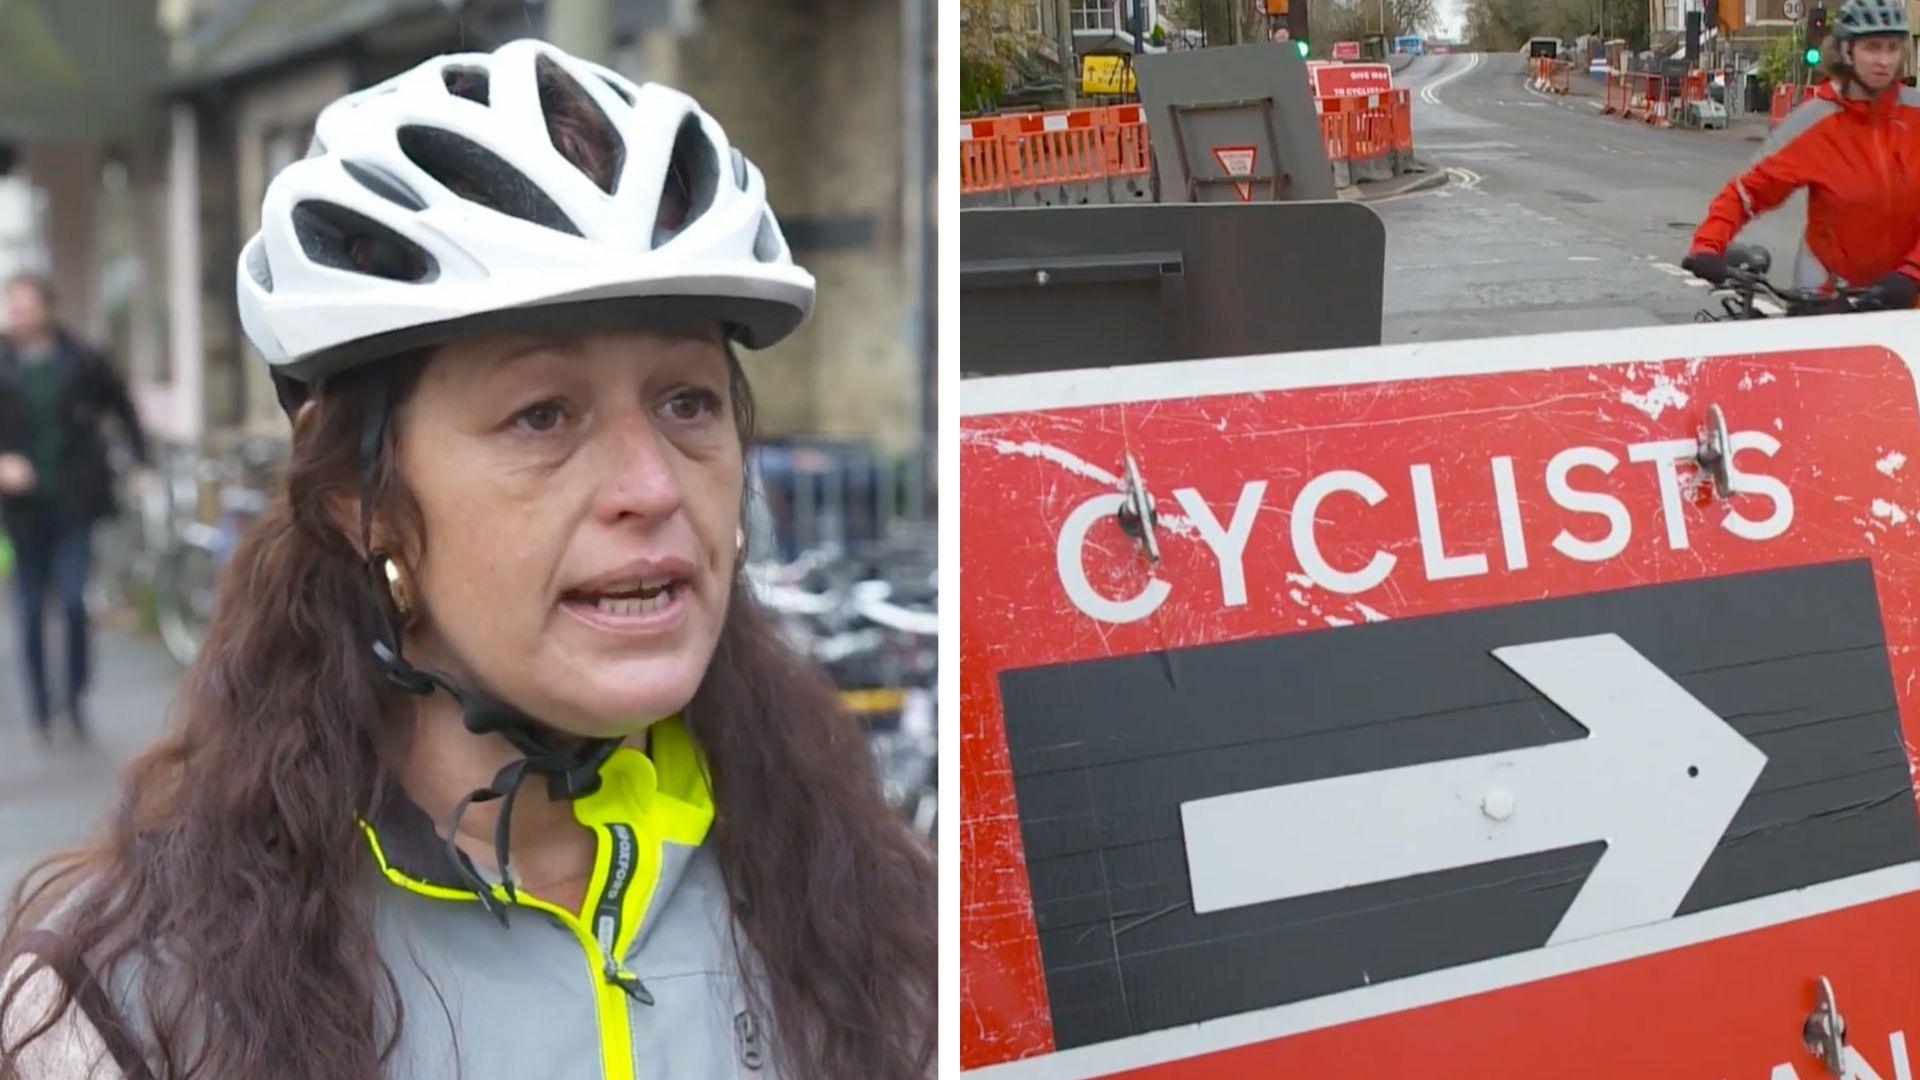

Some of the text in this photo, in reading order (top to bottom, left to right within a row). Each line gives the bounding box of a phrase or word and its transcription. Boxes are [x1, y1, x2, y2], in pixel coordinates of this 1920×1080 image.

[1786, 2, 1802, 14] 30
[1350, 71, 1388, 80] GIVE WAY
[1333, 87, 1345, 97] TO
[1056, 429, 1796, 624] CYCLISTS
[608, 841, 631, 899] OXFORD
